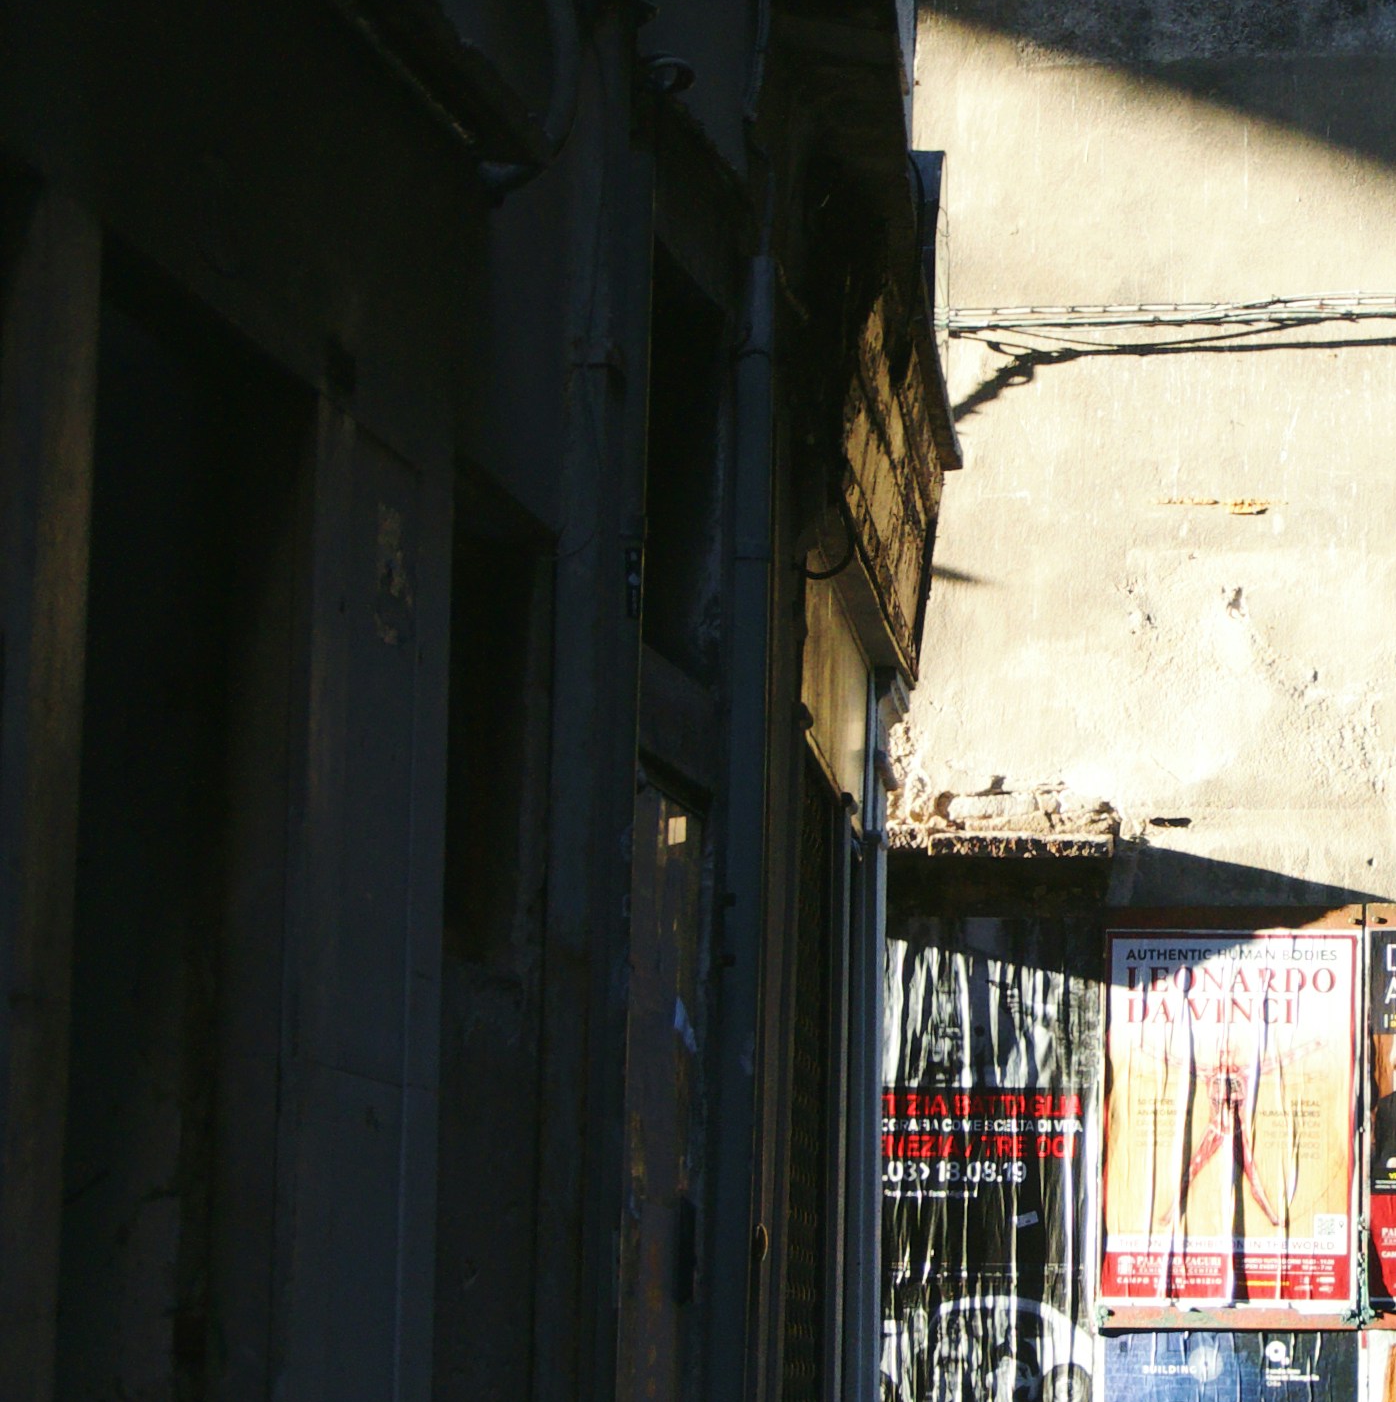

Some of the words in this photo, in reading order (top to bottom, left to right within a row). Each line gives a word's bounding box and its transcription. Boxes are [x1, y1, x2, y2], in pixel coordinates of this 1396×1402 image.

[1126, 948, 1212, 961] AUTHENTIC
[1218, 949, 1276, 961] HUMAN
[1282, 949, 1338, 961] BODIES
[1126, 966, 1337, 994] LEONARDO
[1126, 997, 1175, 1024] DA
[1186, 997, 1293, 1024] VINCI
[1142, 1364, 1197, 1374] BUILDING
